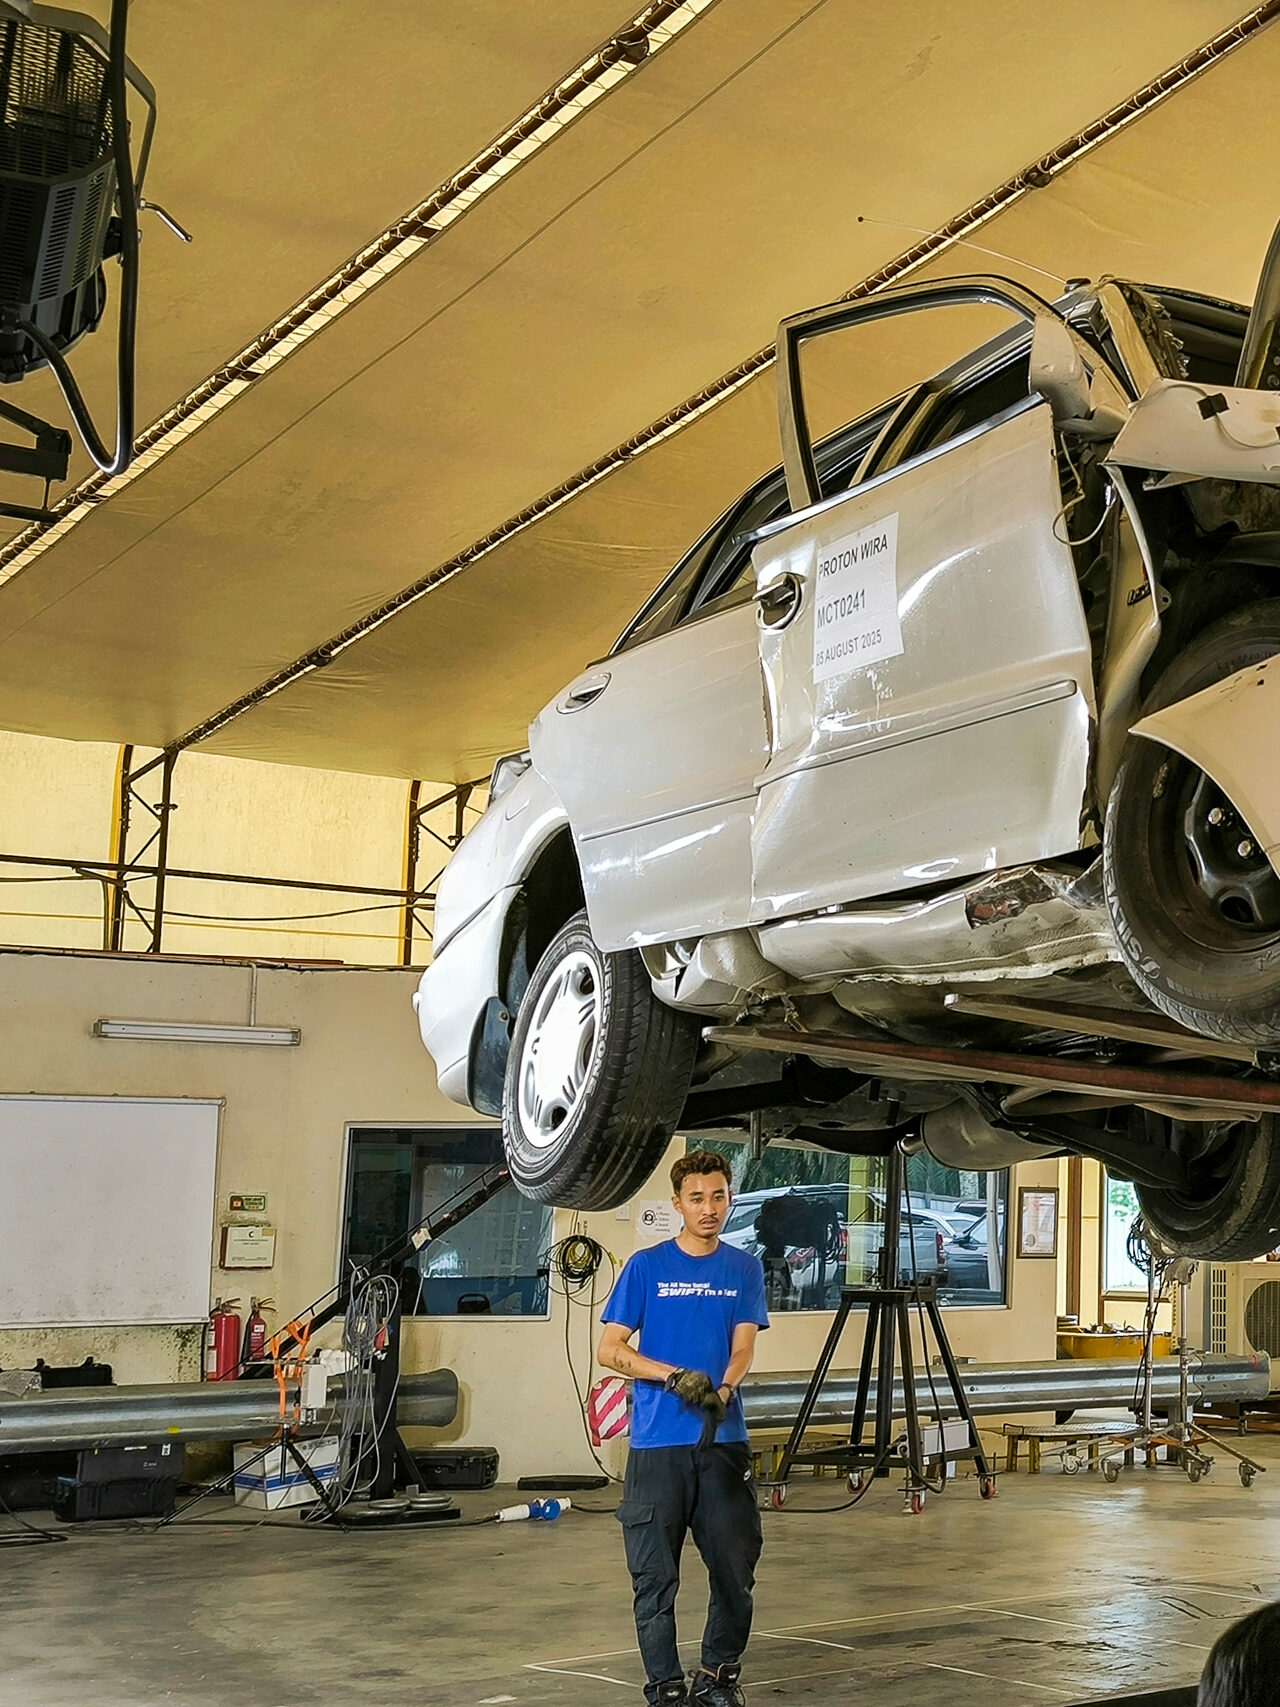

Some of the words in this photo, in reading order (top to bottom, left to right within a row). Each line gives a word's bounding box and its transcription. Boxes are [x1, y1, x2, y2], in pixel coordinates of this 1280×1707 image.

[818, 547, 858, 580] PROTON
[861, 534, 887, 560] WIRA
[817, 588, 865, 628] MCT0241
[825, 637, 859, 662] AUGUST
[861, 629, 882, 649] 2025
